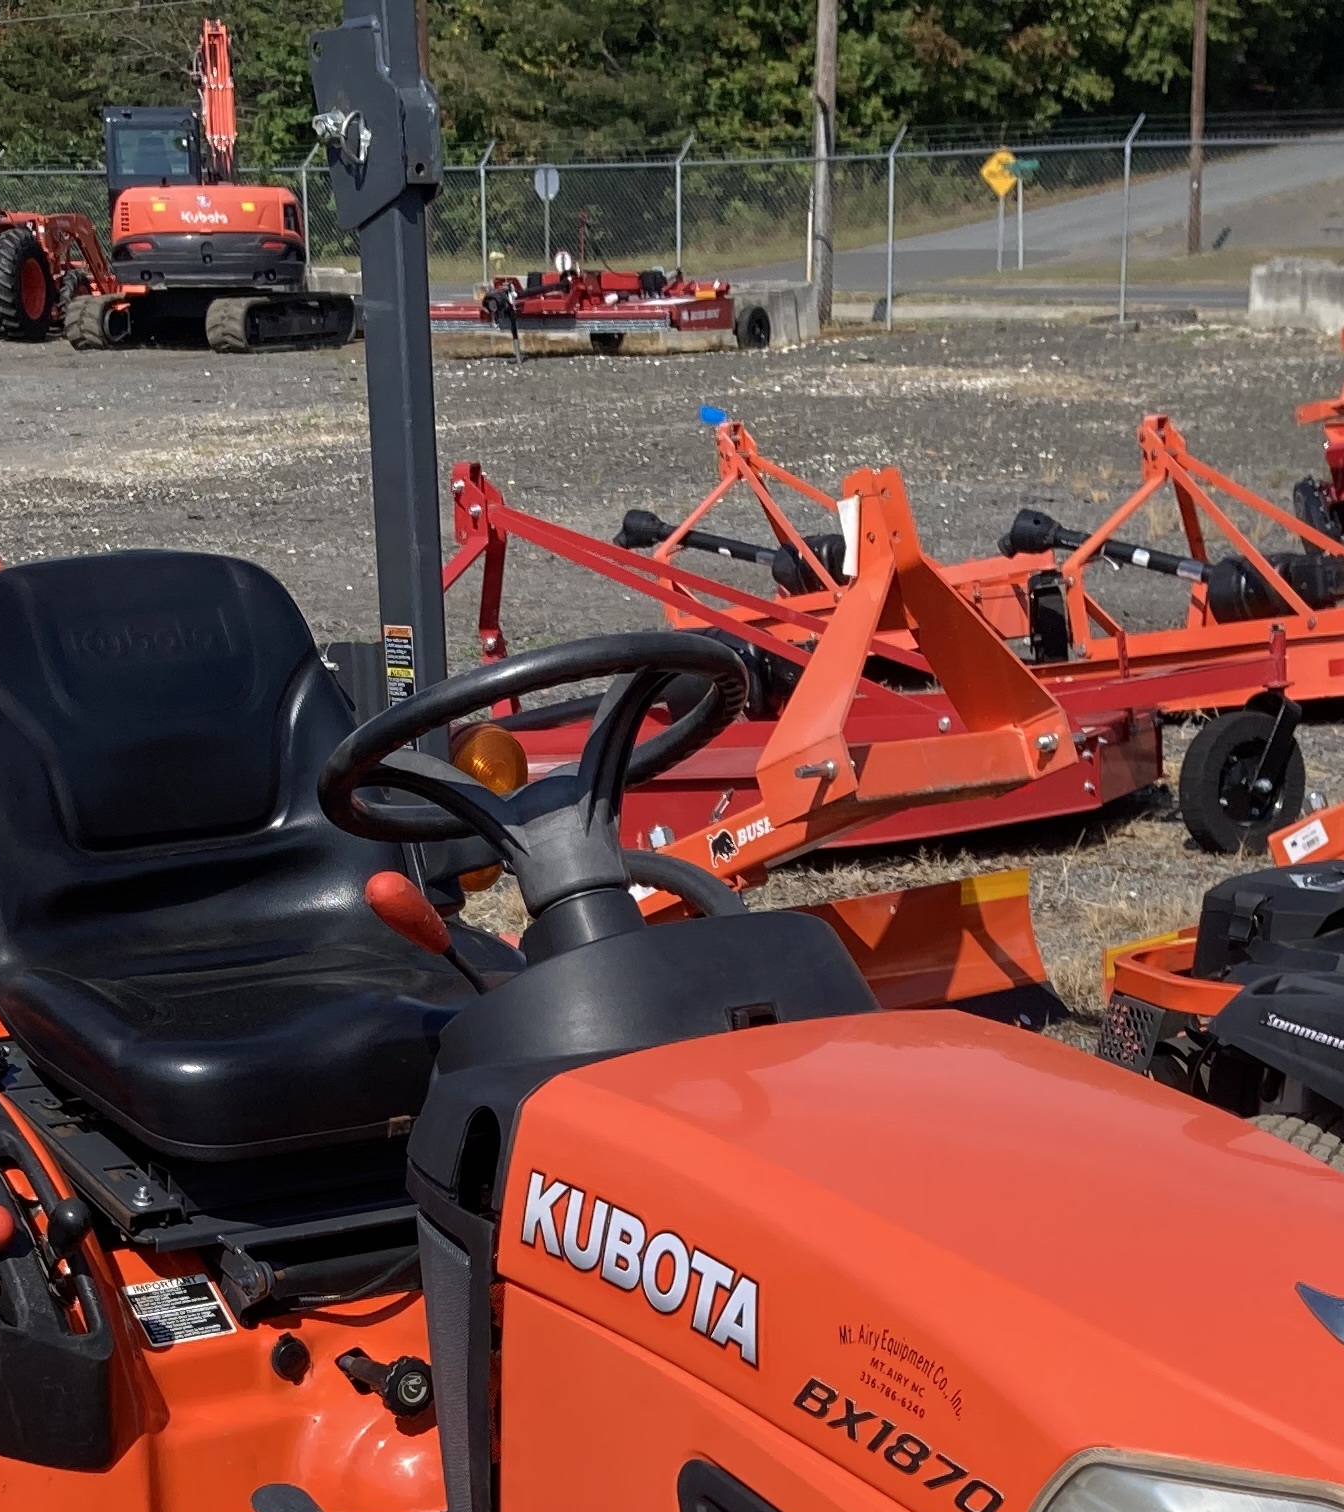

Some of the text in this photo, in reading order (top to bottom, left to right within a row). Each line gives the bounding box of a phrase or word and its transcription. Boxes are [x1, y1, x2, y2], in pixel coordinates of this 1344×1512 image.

[180, 210, 229, 224] Kubota
[132, 1275, 197, 1295] IMPORTANT
[520, 1168, 760, 1372] KUBOTA
[858, 1323, 880, 1351] Airy
[880, 1329, 936, 1379] Equipment
[949, 1388, 964, 1422] Inc.
[859, 1371, 926, 1419] 336-786-6240
[910, 1382, 926, 1398] NC
